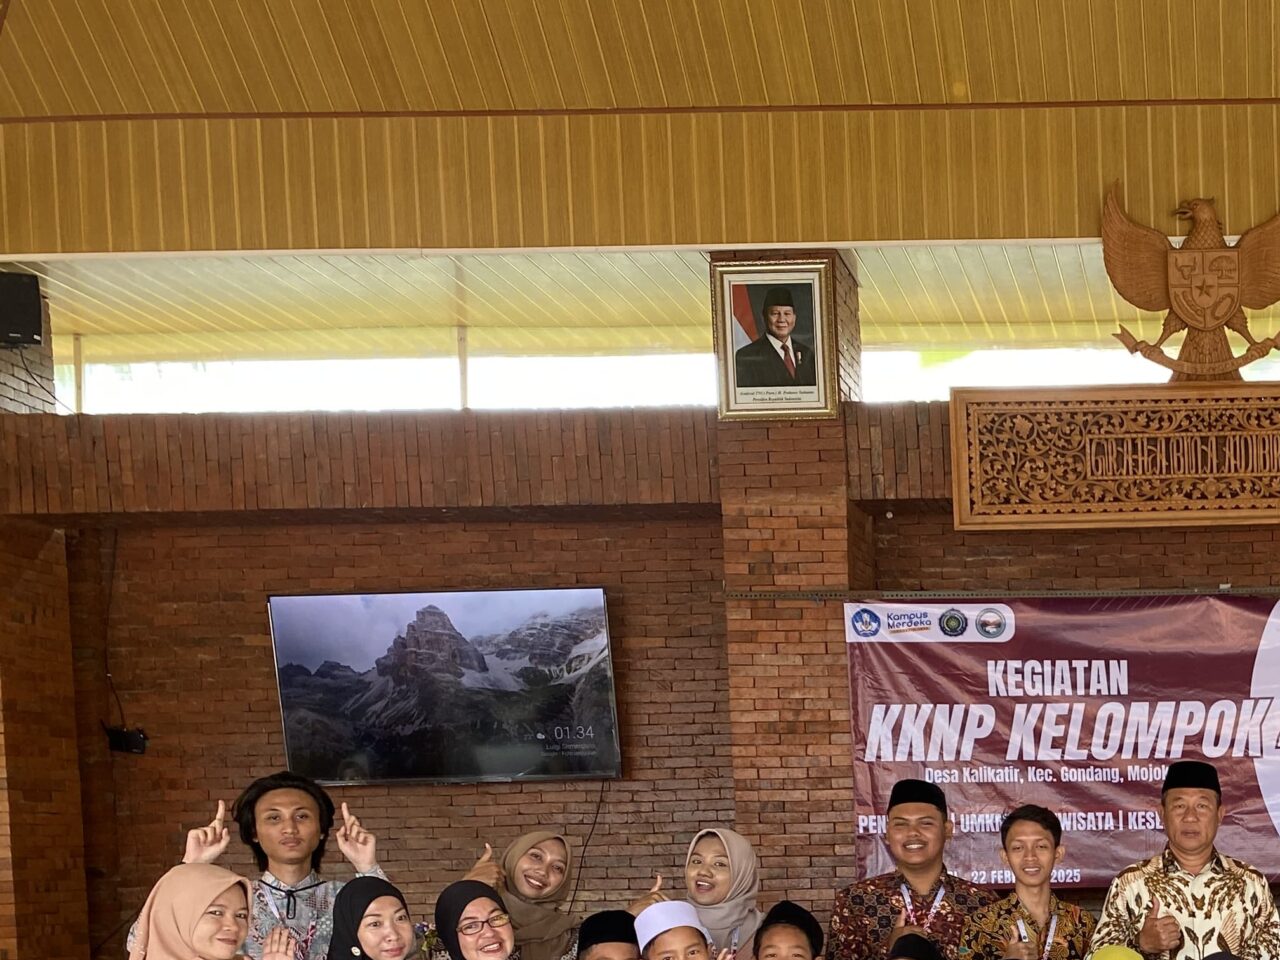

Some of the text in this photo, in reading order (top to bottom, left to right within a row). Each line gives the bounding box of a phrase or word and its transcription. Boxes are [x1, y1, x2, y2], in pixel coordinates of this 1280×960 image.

[887, 611, 928, 622] Kampus
[887, 618, 932, 630] Merdeka
[987, 659, 1129, 697] KEGIATAN
[554, 726, 595, 740] 01.34
[864, 703, 996, 762] KKNP
[1005, 698, 1272, 762] KELOMPOK
[925, 764, 1169, 784] Desa Kalikatir, Kec. Gondang, Mojok
[1057, 811, 1114, 831] WISATA
[971, 870, 988, 884] 22
[1051, 869, 1081, 884] 2025
